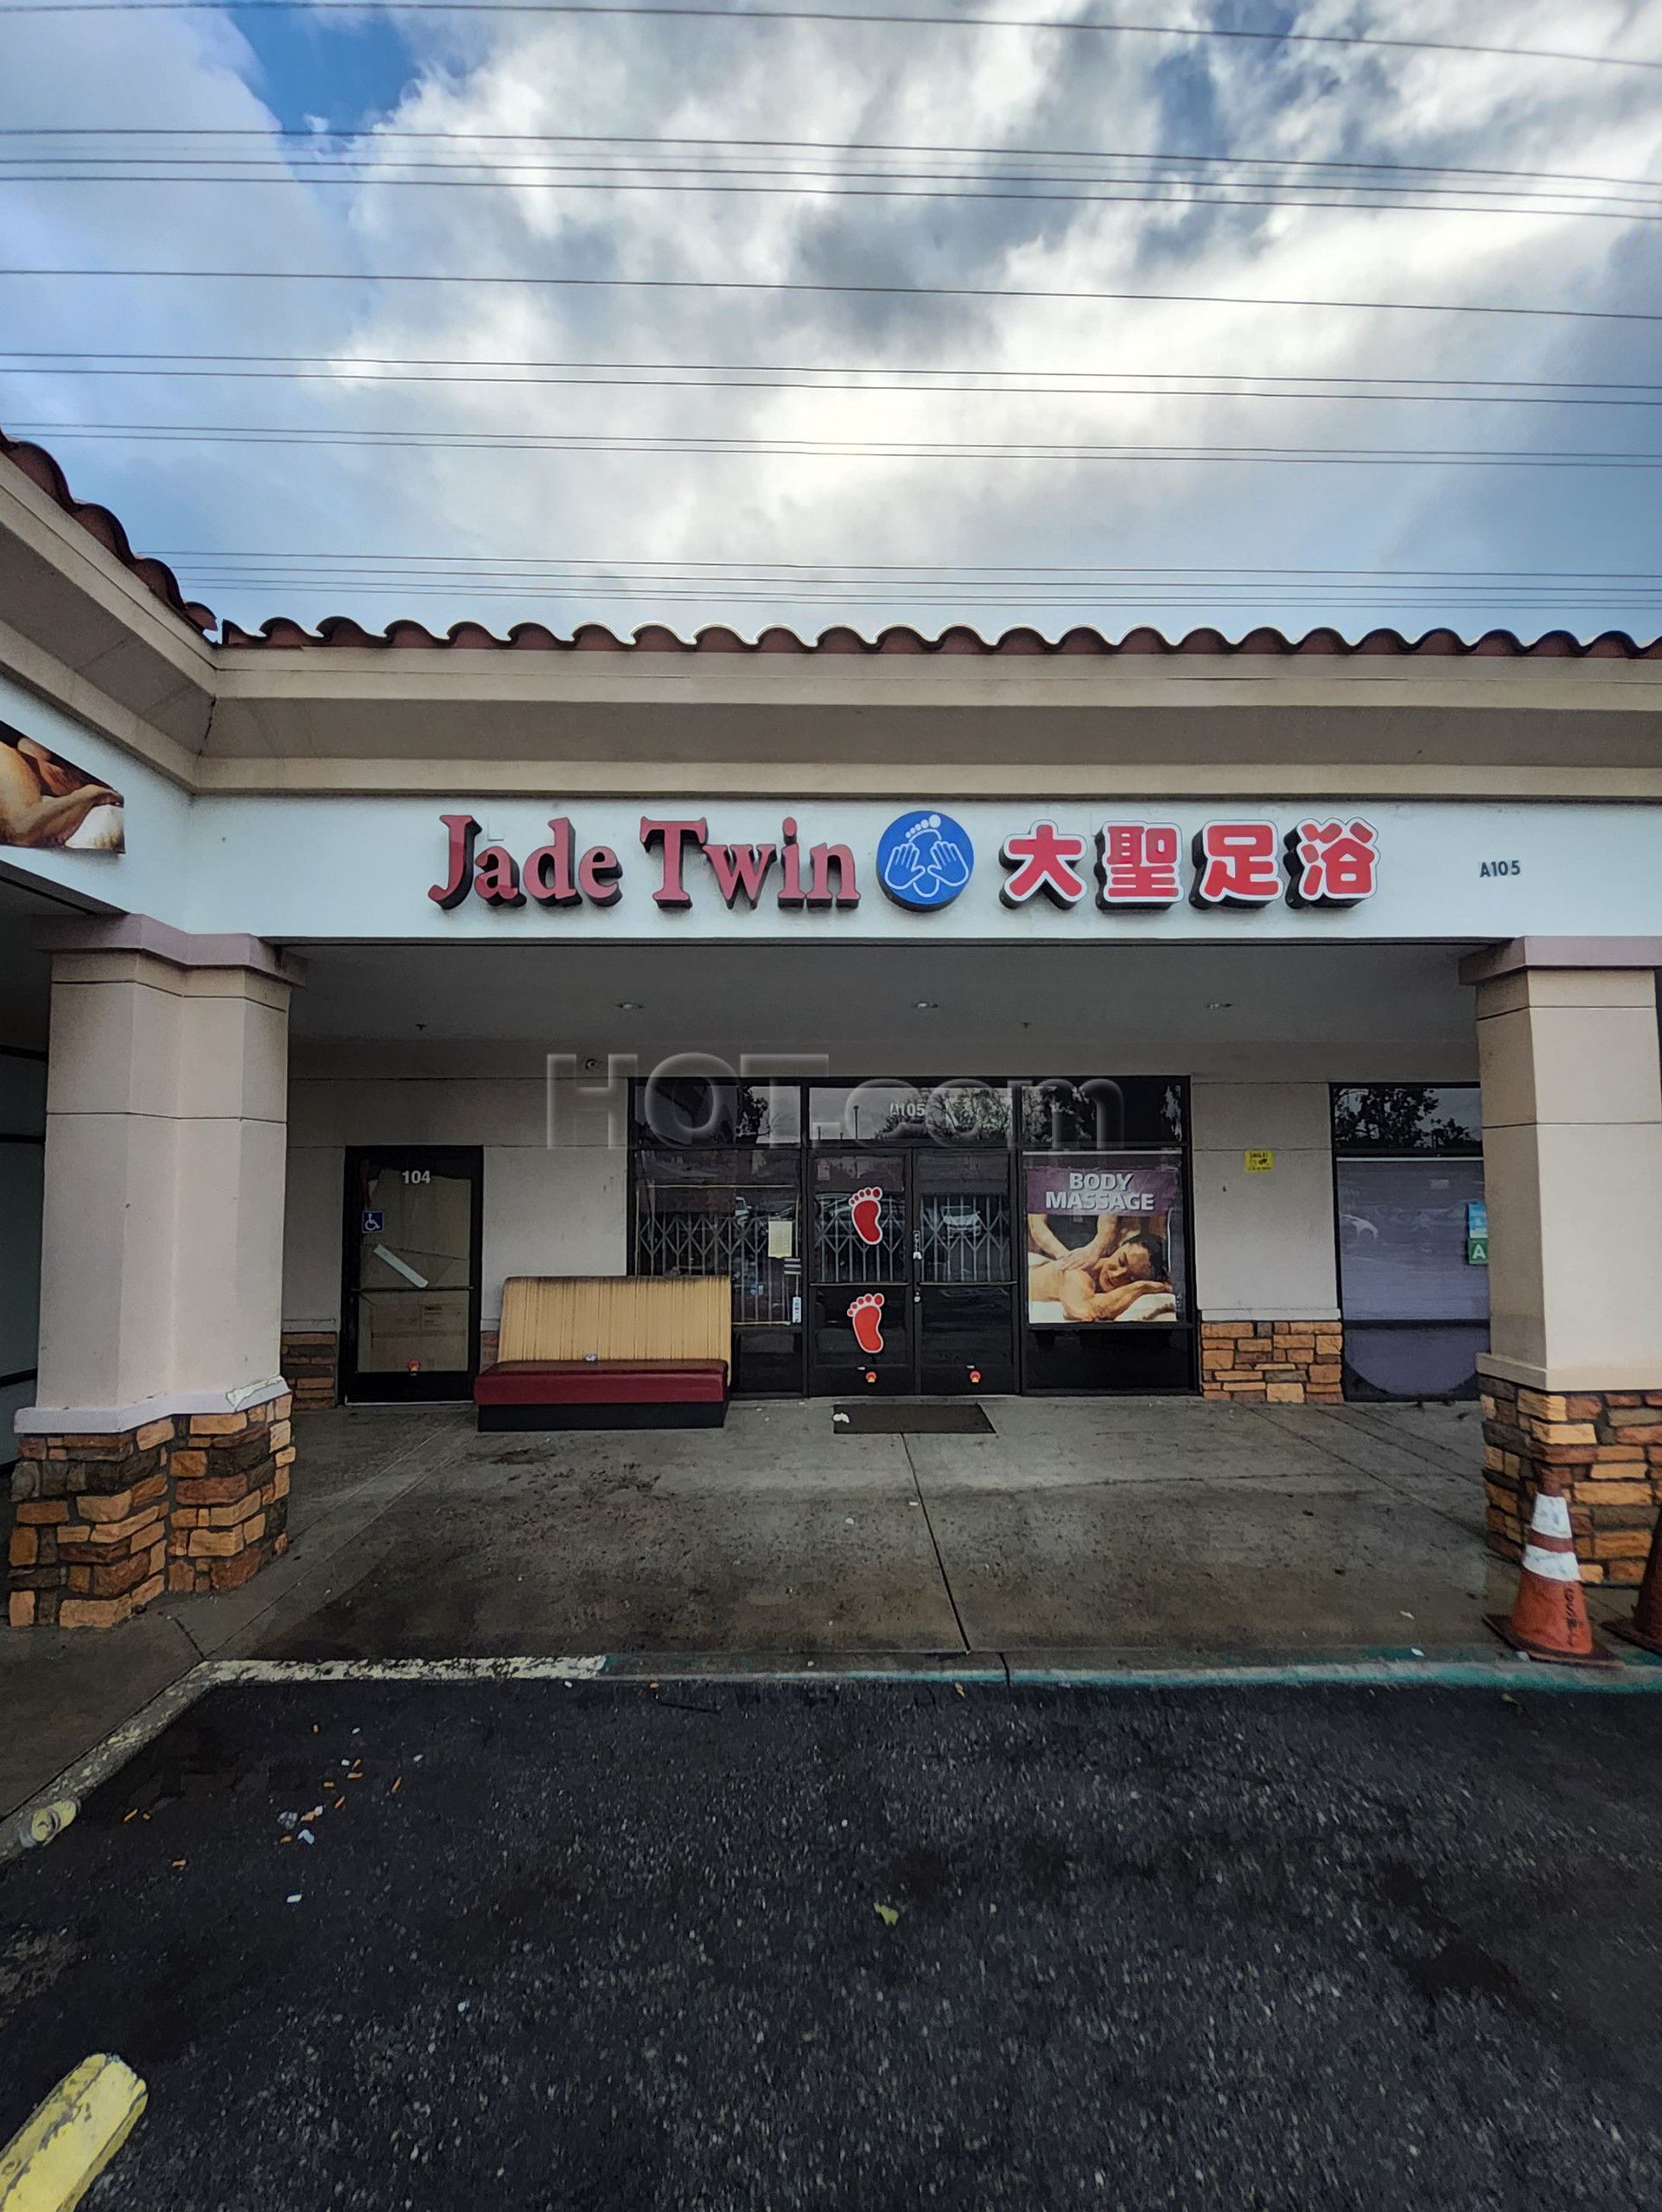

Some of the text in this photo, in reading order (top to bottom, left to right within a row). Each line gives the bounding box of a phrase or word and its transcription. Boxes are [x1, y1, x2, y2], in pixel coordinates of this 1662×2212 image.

[428, 814, 861, 908] Jade Twin
[1000, 817, 1380, 909] 大聖足浴
[1480, 860, 1521, 877] A105
[890, 1103, 926, 1116] A105
[402, 1170, 431, 1184] 104
[1069, 1173, 1134, 1191] BODY
[1046, 1192, 1155, 1211] MASSAGE
[1472, 1244, 1486, 1259] A
